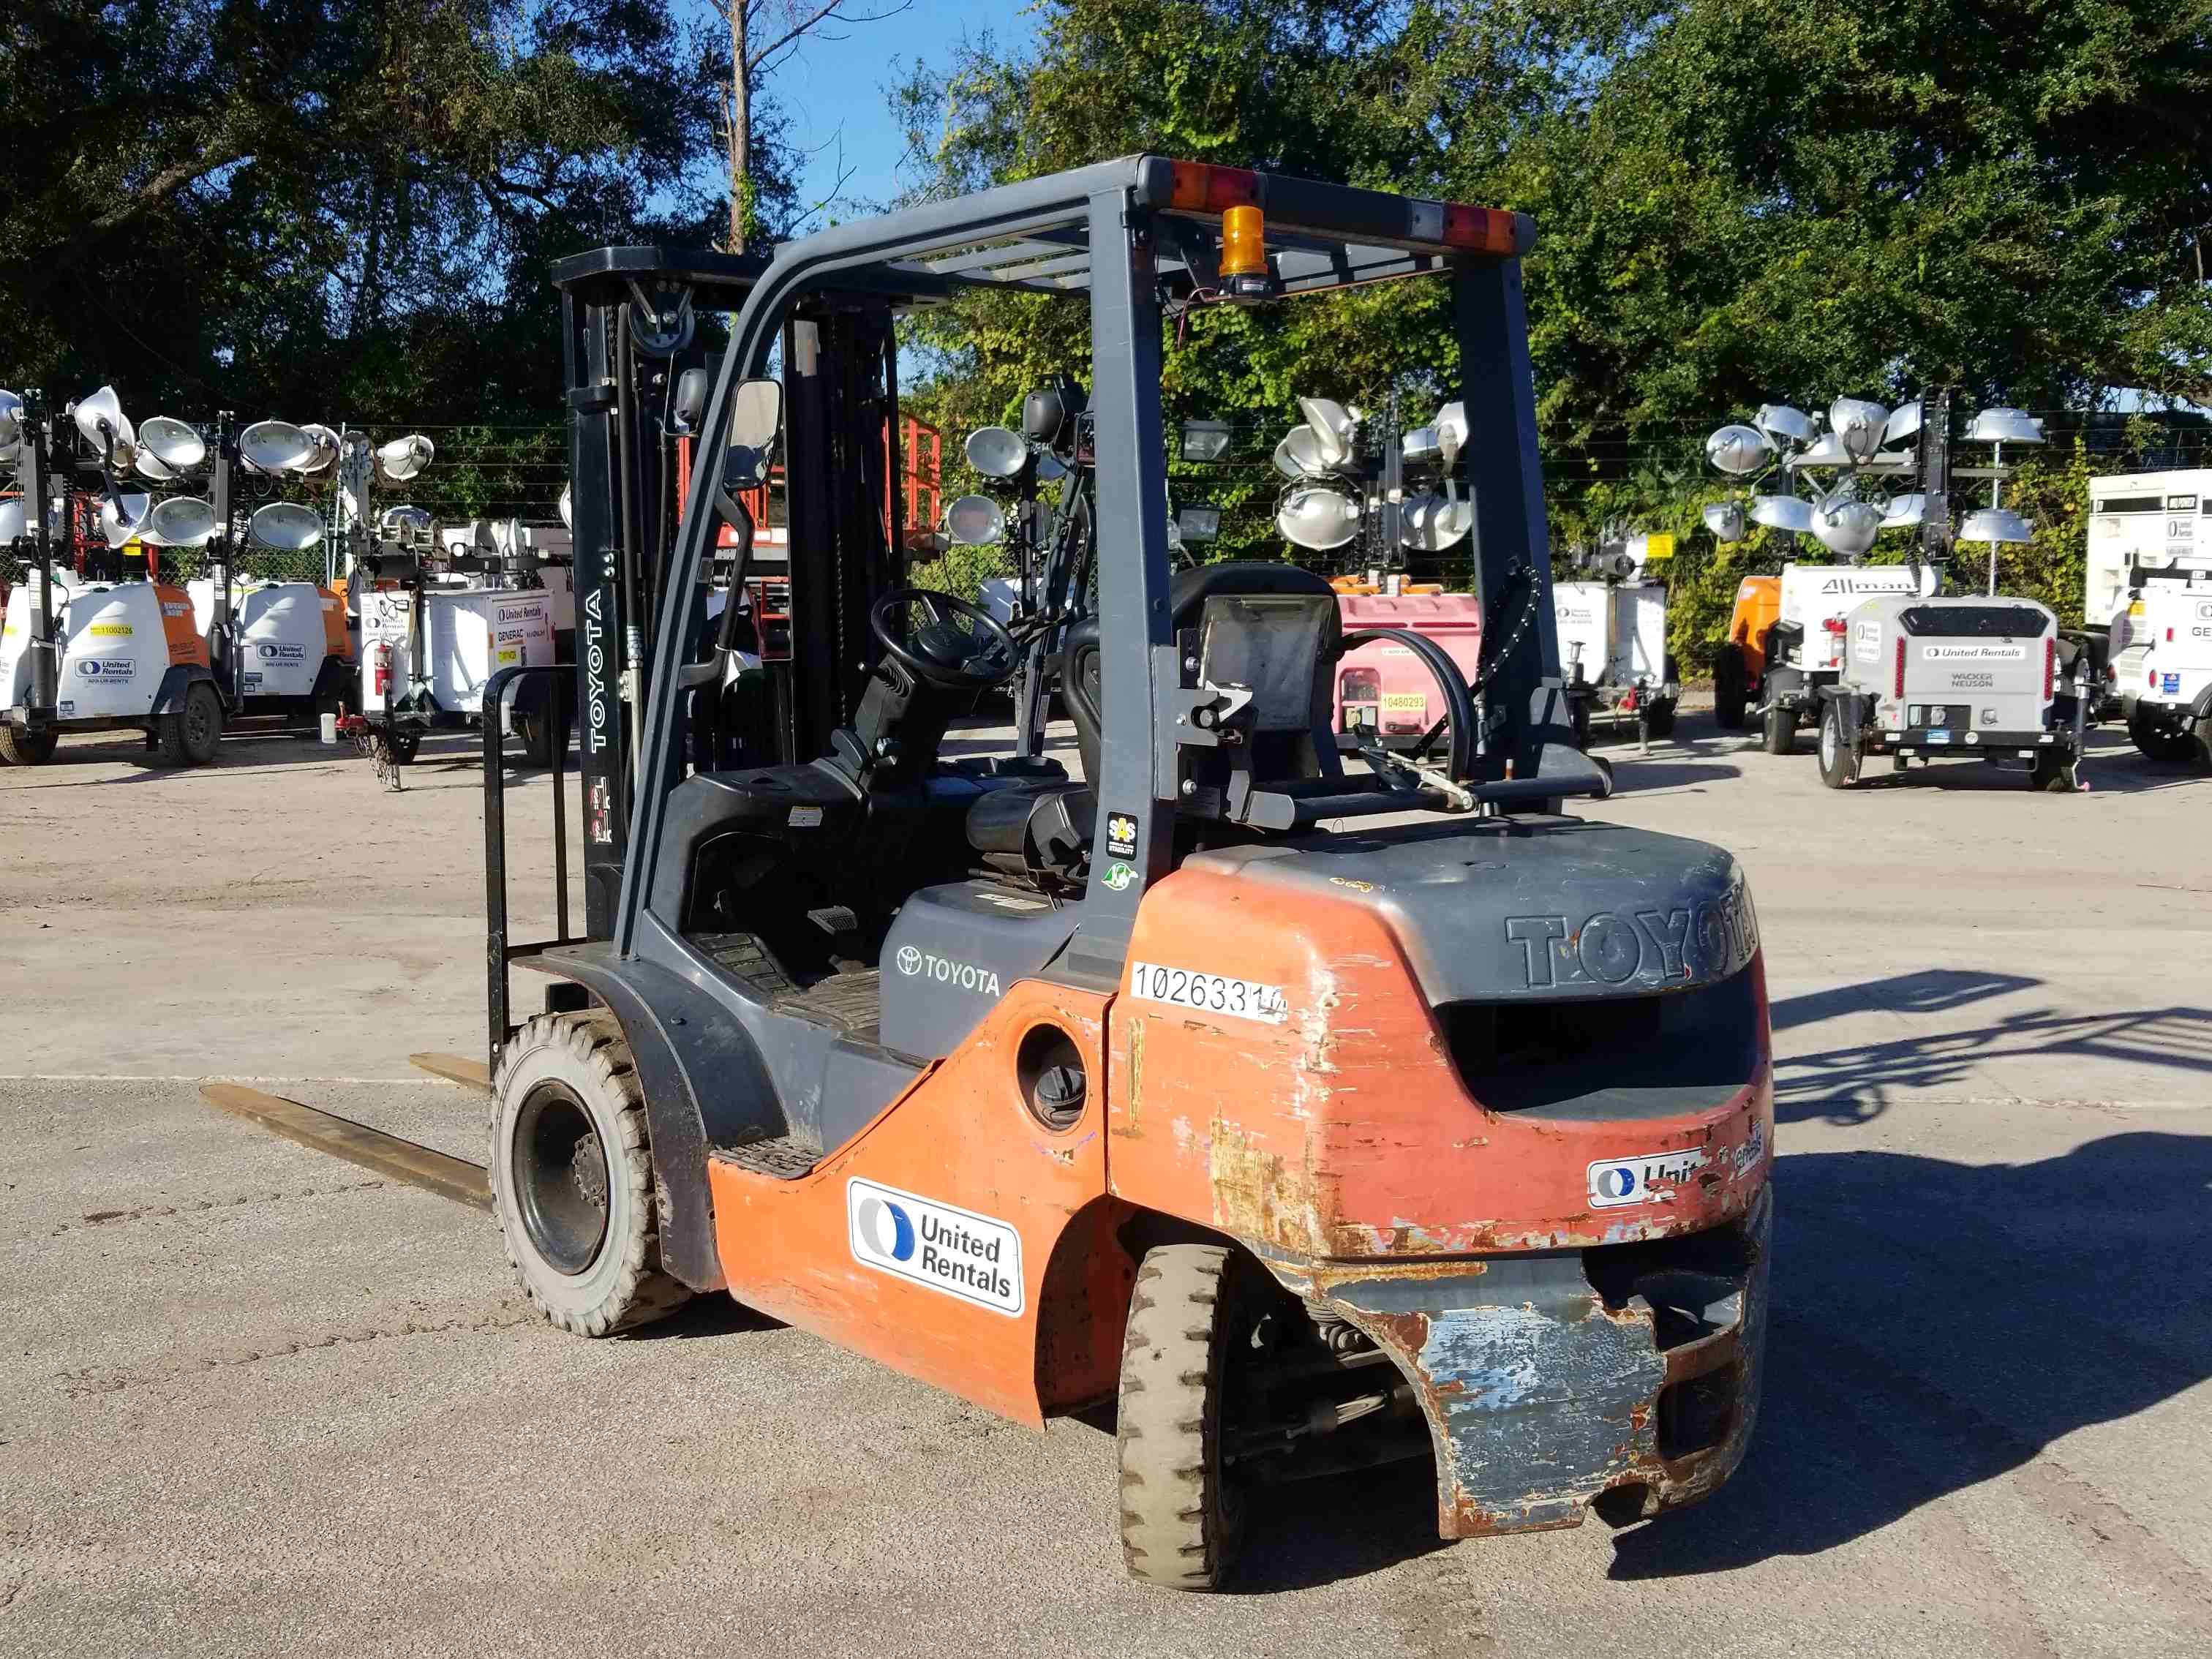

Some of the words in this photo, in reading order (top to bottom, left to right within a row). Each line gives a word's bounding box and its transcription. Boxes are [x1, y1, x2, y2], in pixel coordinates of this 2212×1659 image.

[1821, 579, 1914, 593] Allman
[505, 608, 522, 620] United
[498, 629, 524, 642] GENERAC
[1942, 648, 1978, 657] United
[1981, 648, 2020, 657] Rentals
[102, 661, 130, 669] United
[585, 589, 606, 753] TOYOTA
[1383, 697, 1424, 707] 10480293
[1109, 818, 1135, 842] SAS
[925, 955, 1000, 997] TOYOTA
[922, 1214, 1001, 1263] United
[922, 1244, 1012, 1298] Rentals
